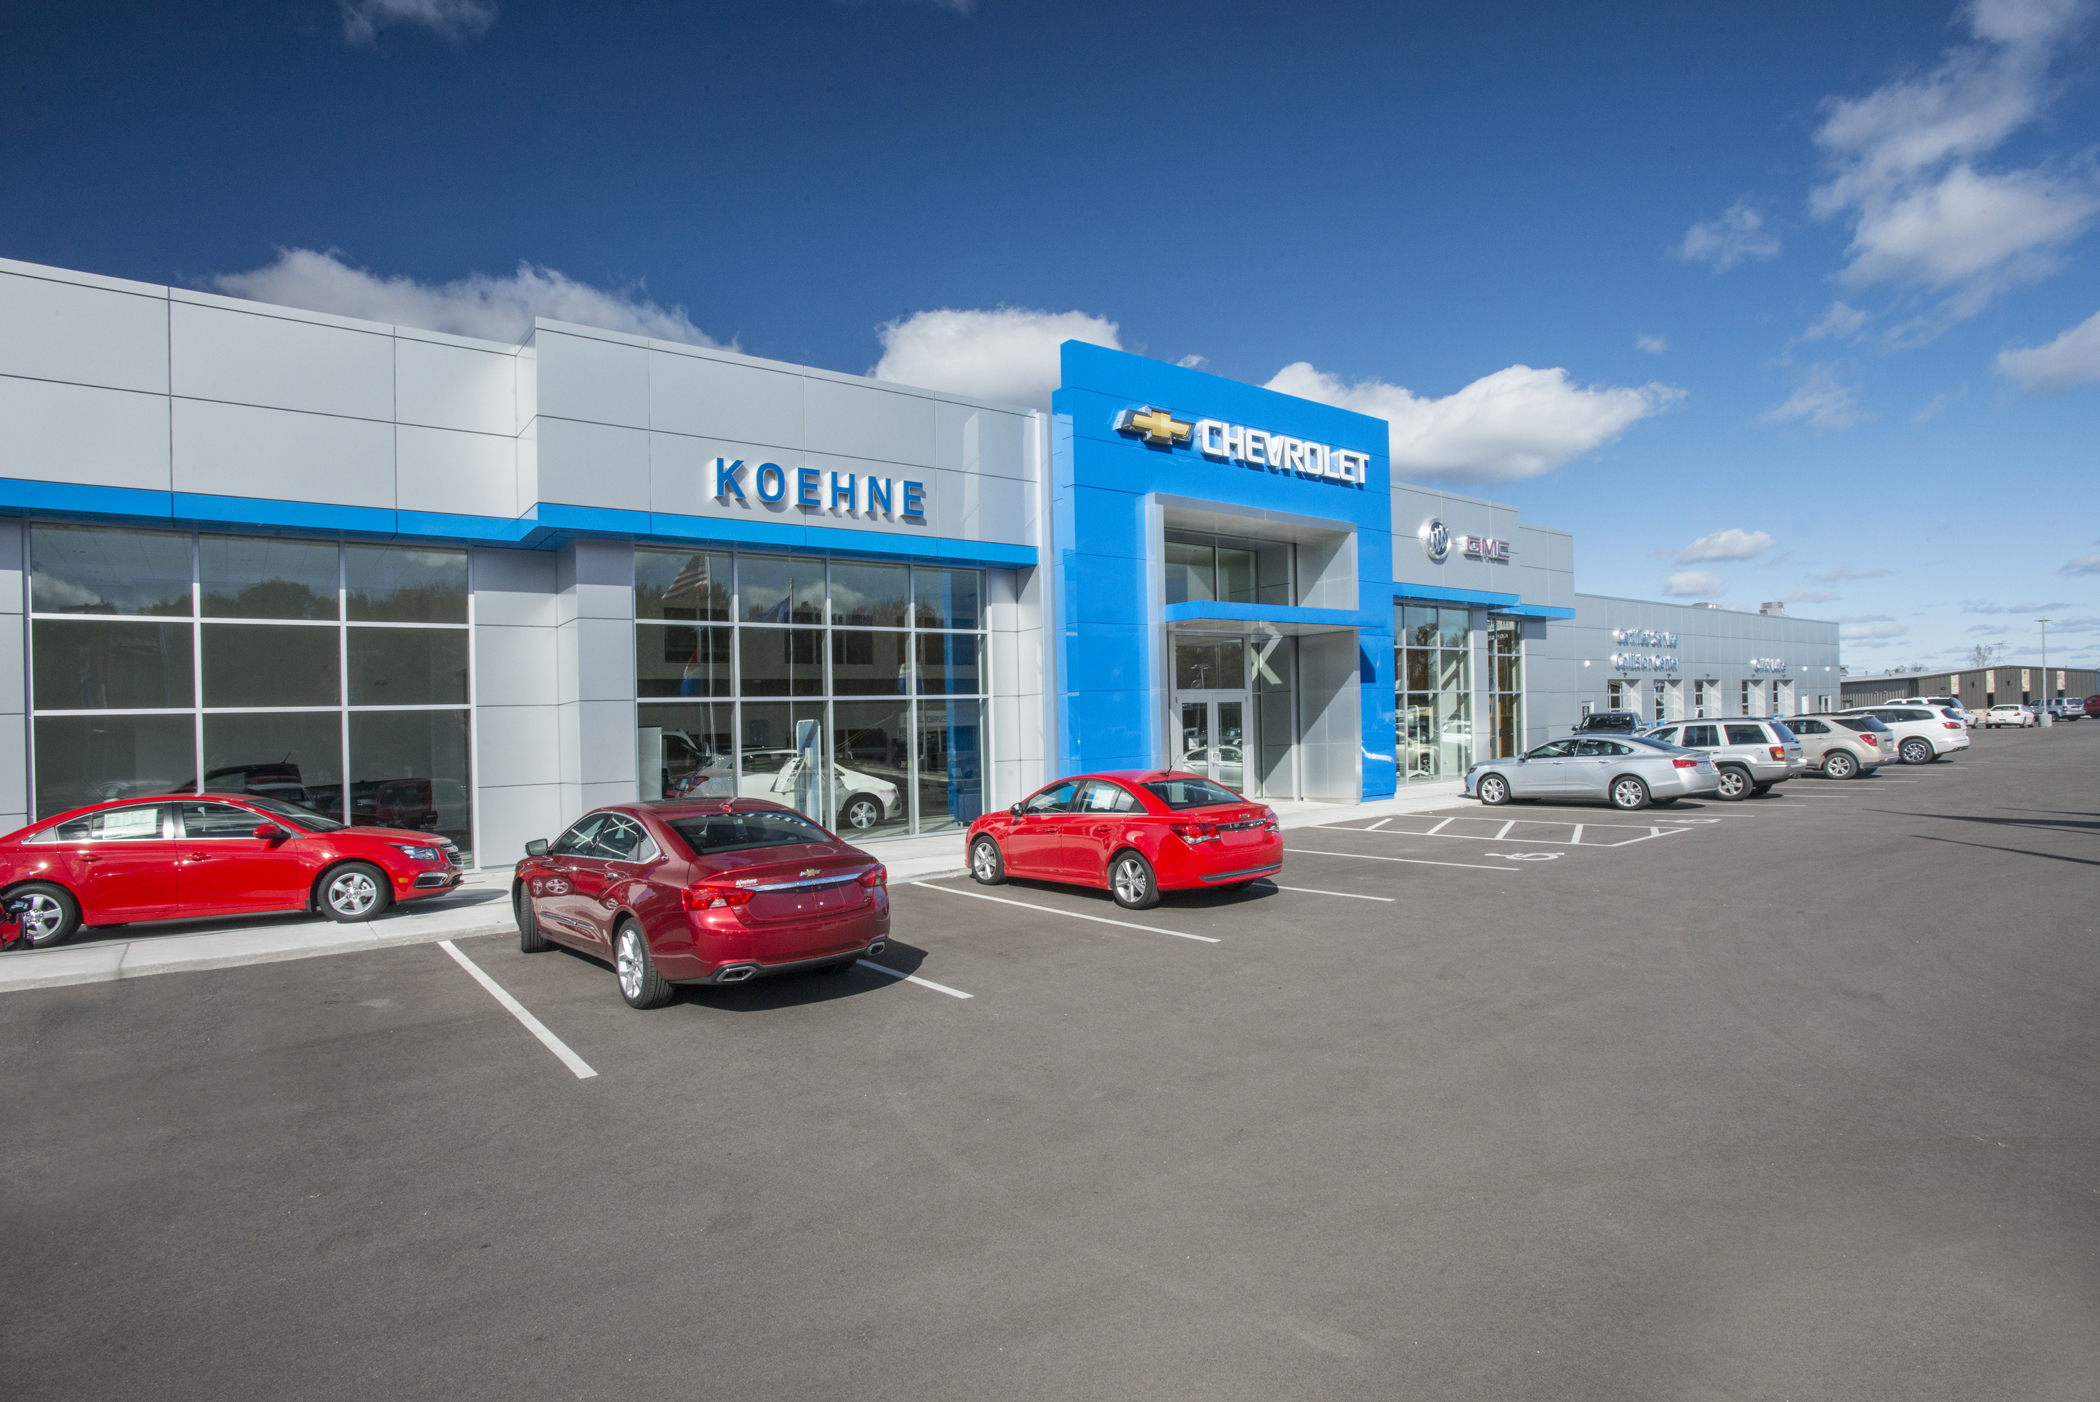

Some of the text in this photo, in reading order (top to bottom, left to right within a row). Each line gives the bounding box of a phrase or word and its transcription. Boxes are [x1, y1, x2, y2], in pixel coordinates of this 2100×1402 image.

[1199, 419, 1370, 484] CHEVROLET
[714, 457, 925, 517] KOEHNE
[1466, 535, 1510, 559] GMC
